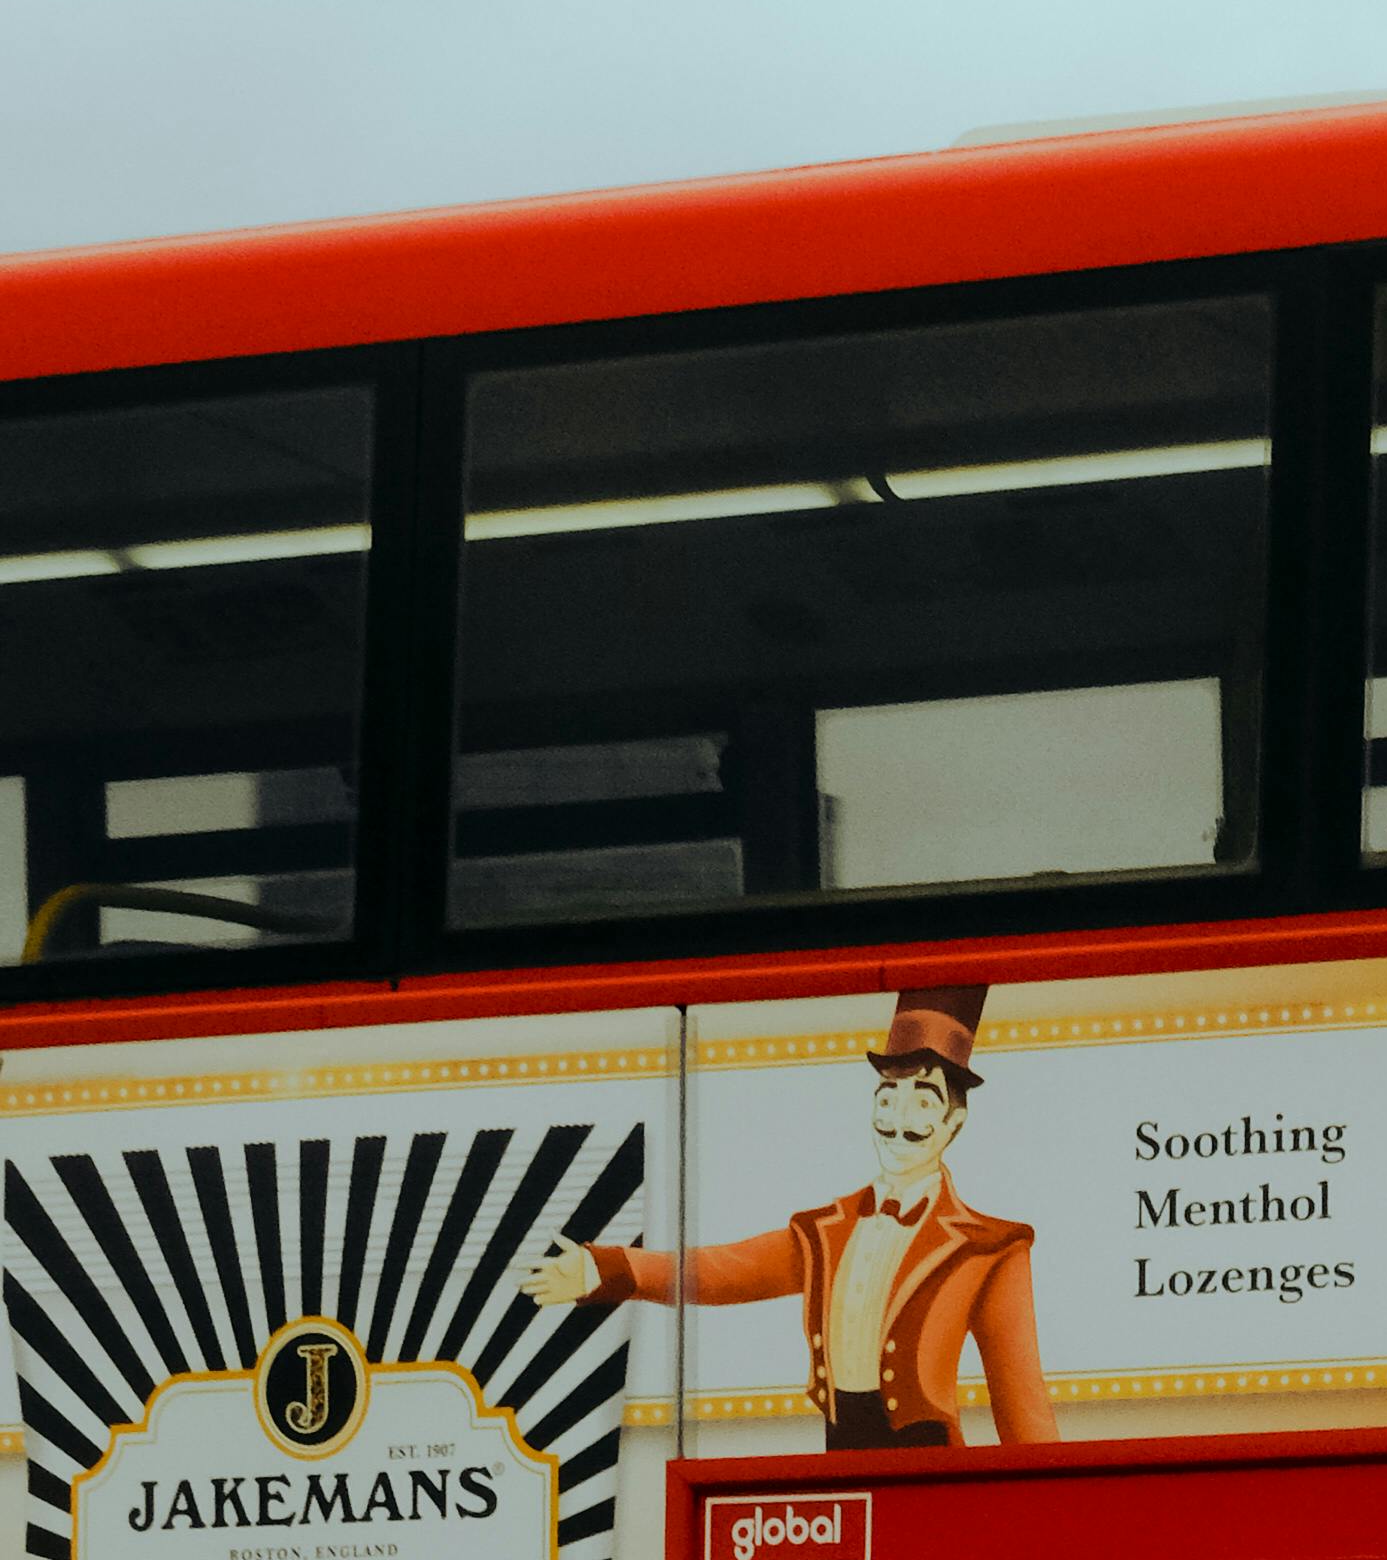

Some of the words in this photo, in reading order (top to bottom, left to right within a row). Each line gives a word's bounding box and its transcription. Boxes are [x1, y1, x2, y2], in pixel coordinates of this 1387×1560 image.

[1134, 1114, 1347, 1165] Soothing
[1134, 1181, 1331, 1230] Menthol
[1134, 1255, 1356, 1304] Lozenges
[285, 1344, 338, 1433] J
[128, 1466, 498, 1532] JAKEMANS
[315, 1543, 399, 1560] ENGLAND
